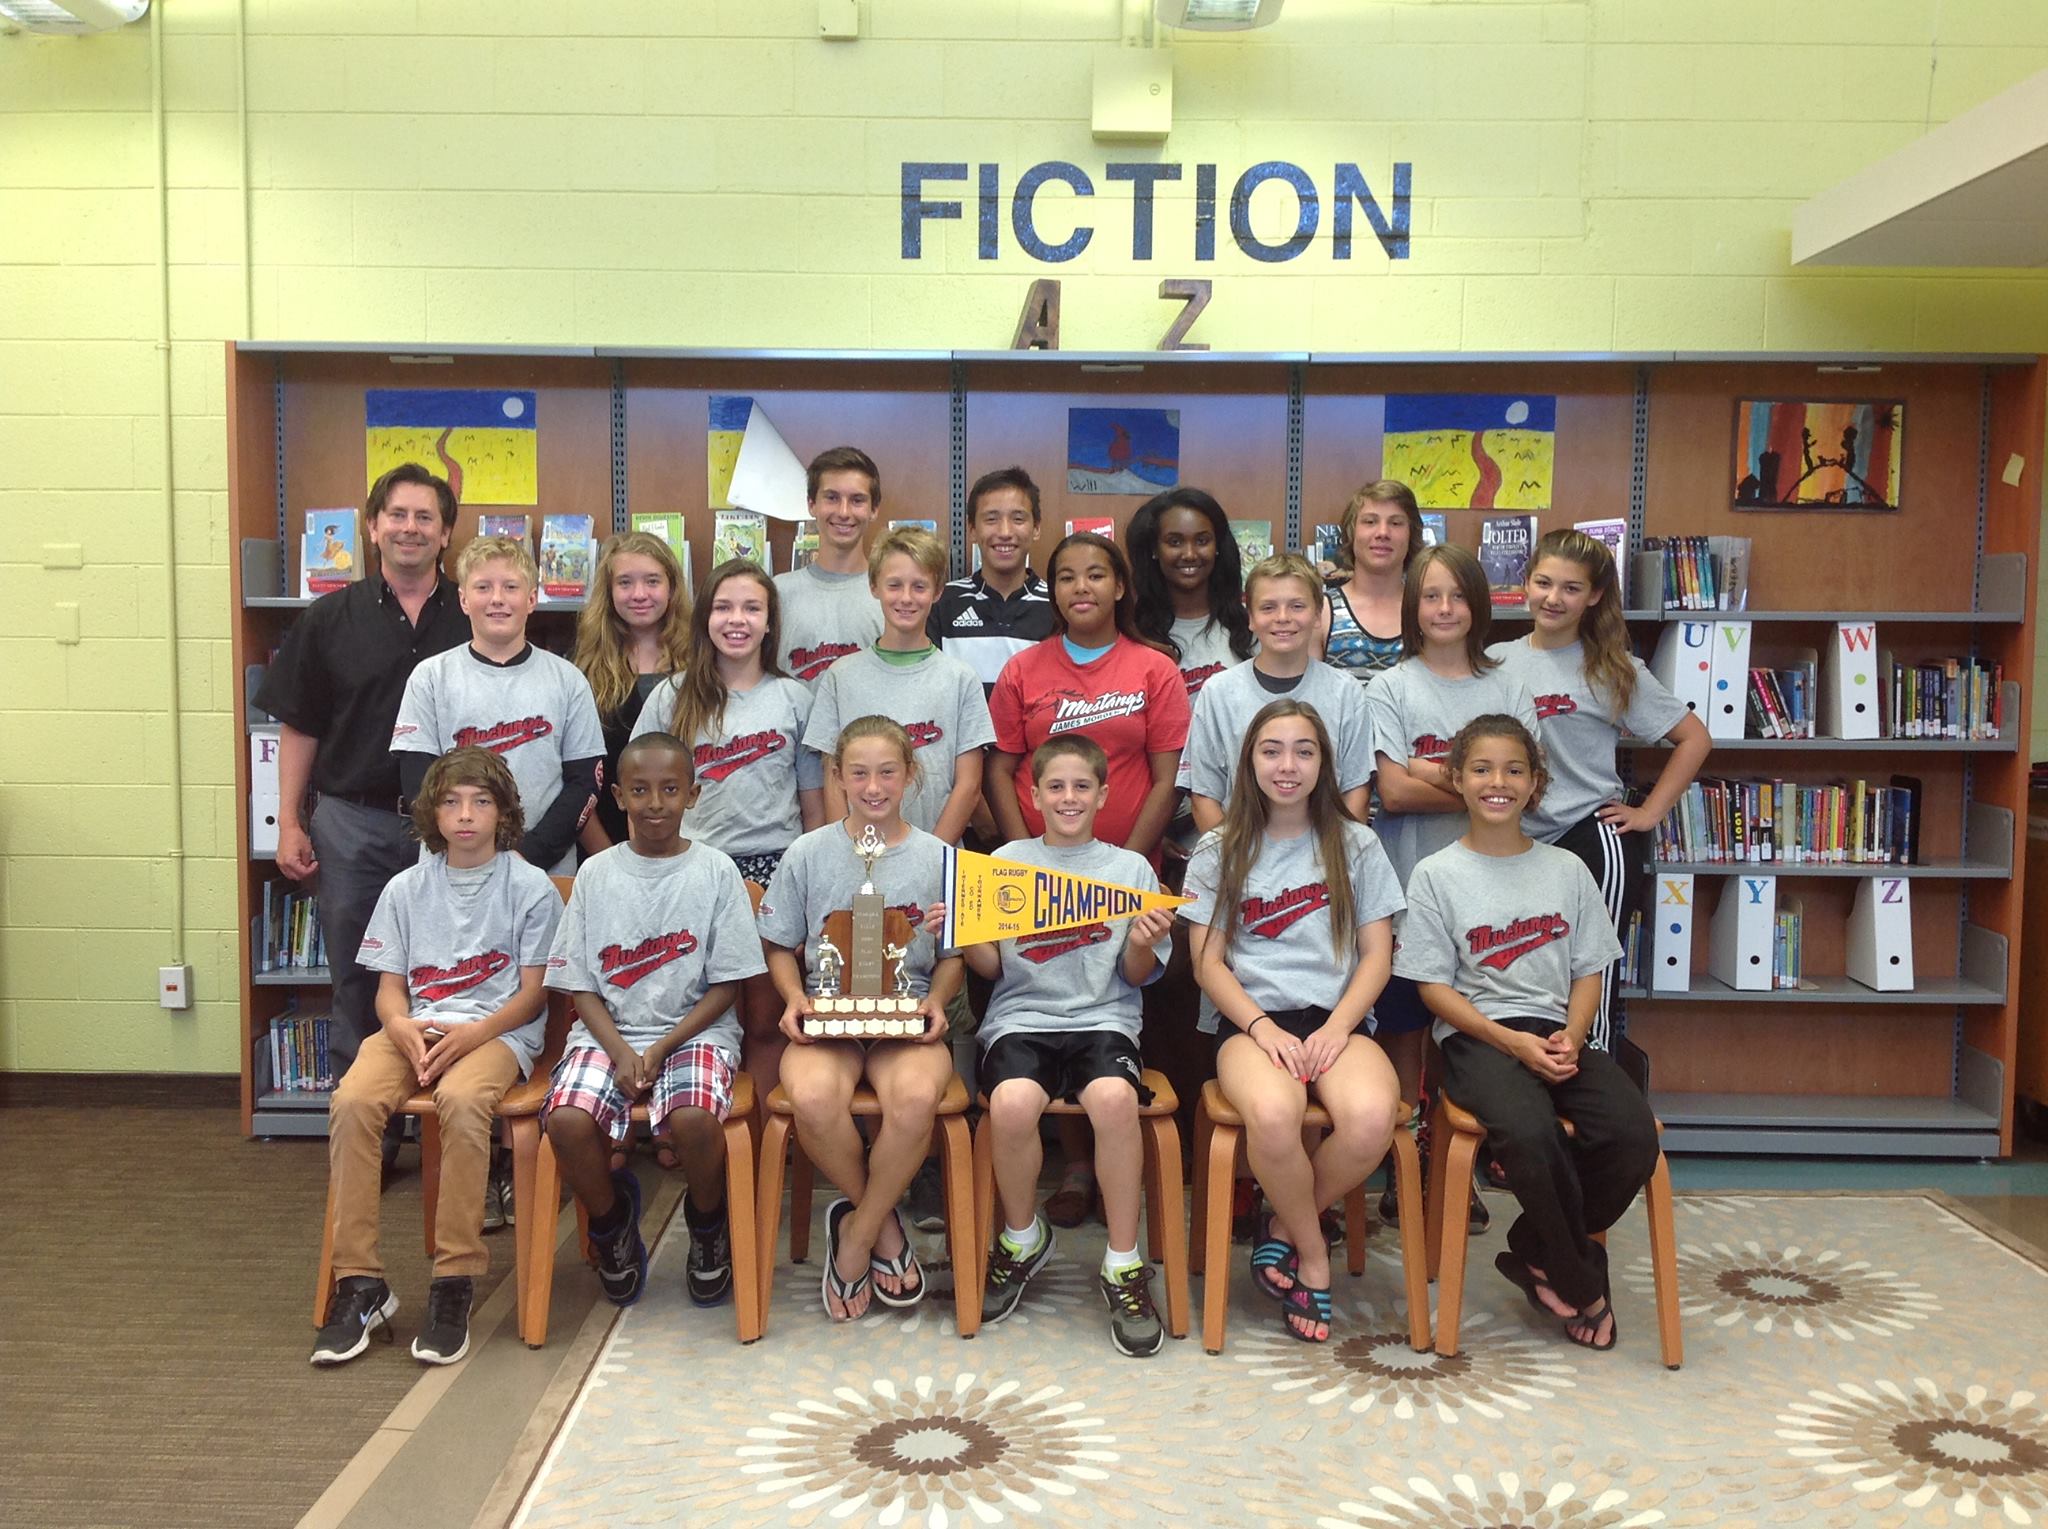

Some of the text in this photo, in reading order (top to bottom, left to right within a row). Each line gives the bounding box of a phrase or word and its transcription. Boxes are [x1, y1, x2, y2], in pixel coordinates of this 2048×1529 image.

[901, 161, 1412, 263] FICTION
[1011, 278, 1212, 350] A Z
[952, 619, 984, 627] adidas
[1683, 622, 1708, 648] U
[1722, 626, 1747, 652] V
[1841, 626, 1874, 652] W
[1056, 691, 1145, 717] Mustangs
[453, 715, 552, 748] Mustangs
[1052, 720, 1081, 733] JAMES
[259, 739, 279, 763] F
[694, 729, 786, 768] Mustangs
[1735, 812, 1743, 840] LOOT
[992, 868, 1028, 877] FLAG RUGBY
[1034, 872, 1142, 929] CHAMPION
[1661, 880, 1690, 905] X
[1745, 880, 1769, 904] Y
[1881, 880, 1904, 904] Z
[998, 922, 1020, 931] 2014-15
[1465, 913, 1569, 955] Mustangs
[598, 928, 698, 972] Mustangs
[409, 949, 510, 987] Mustangs
